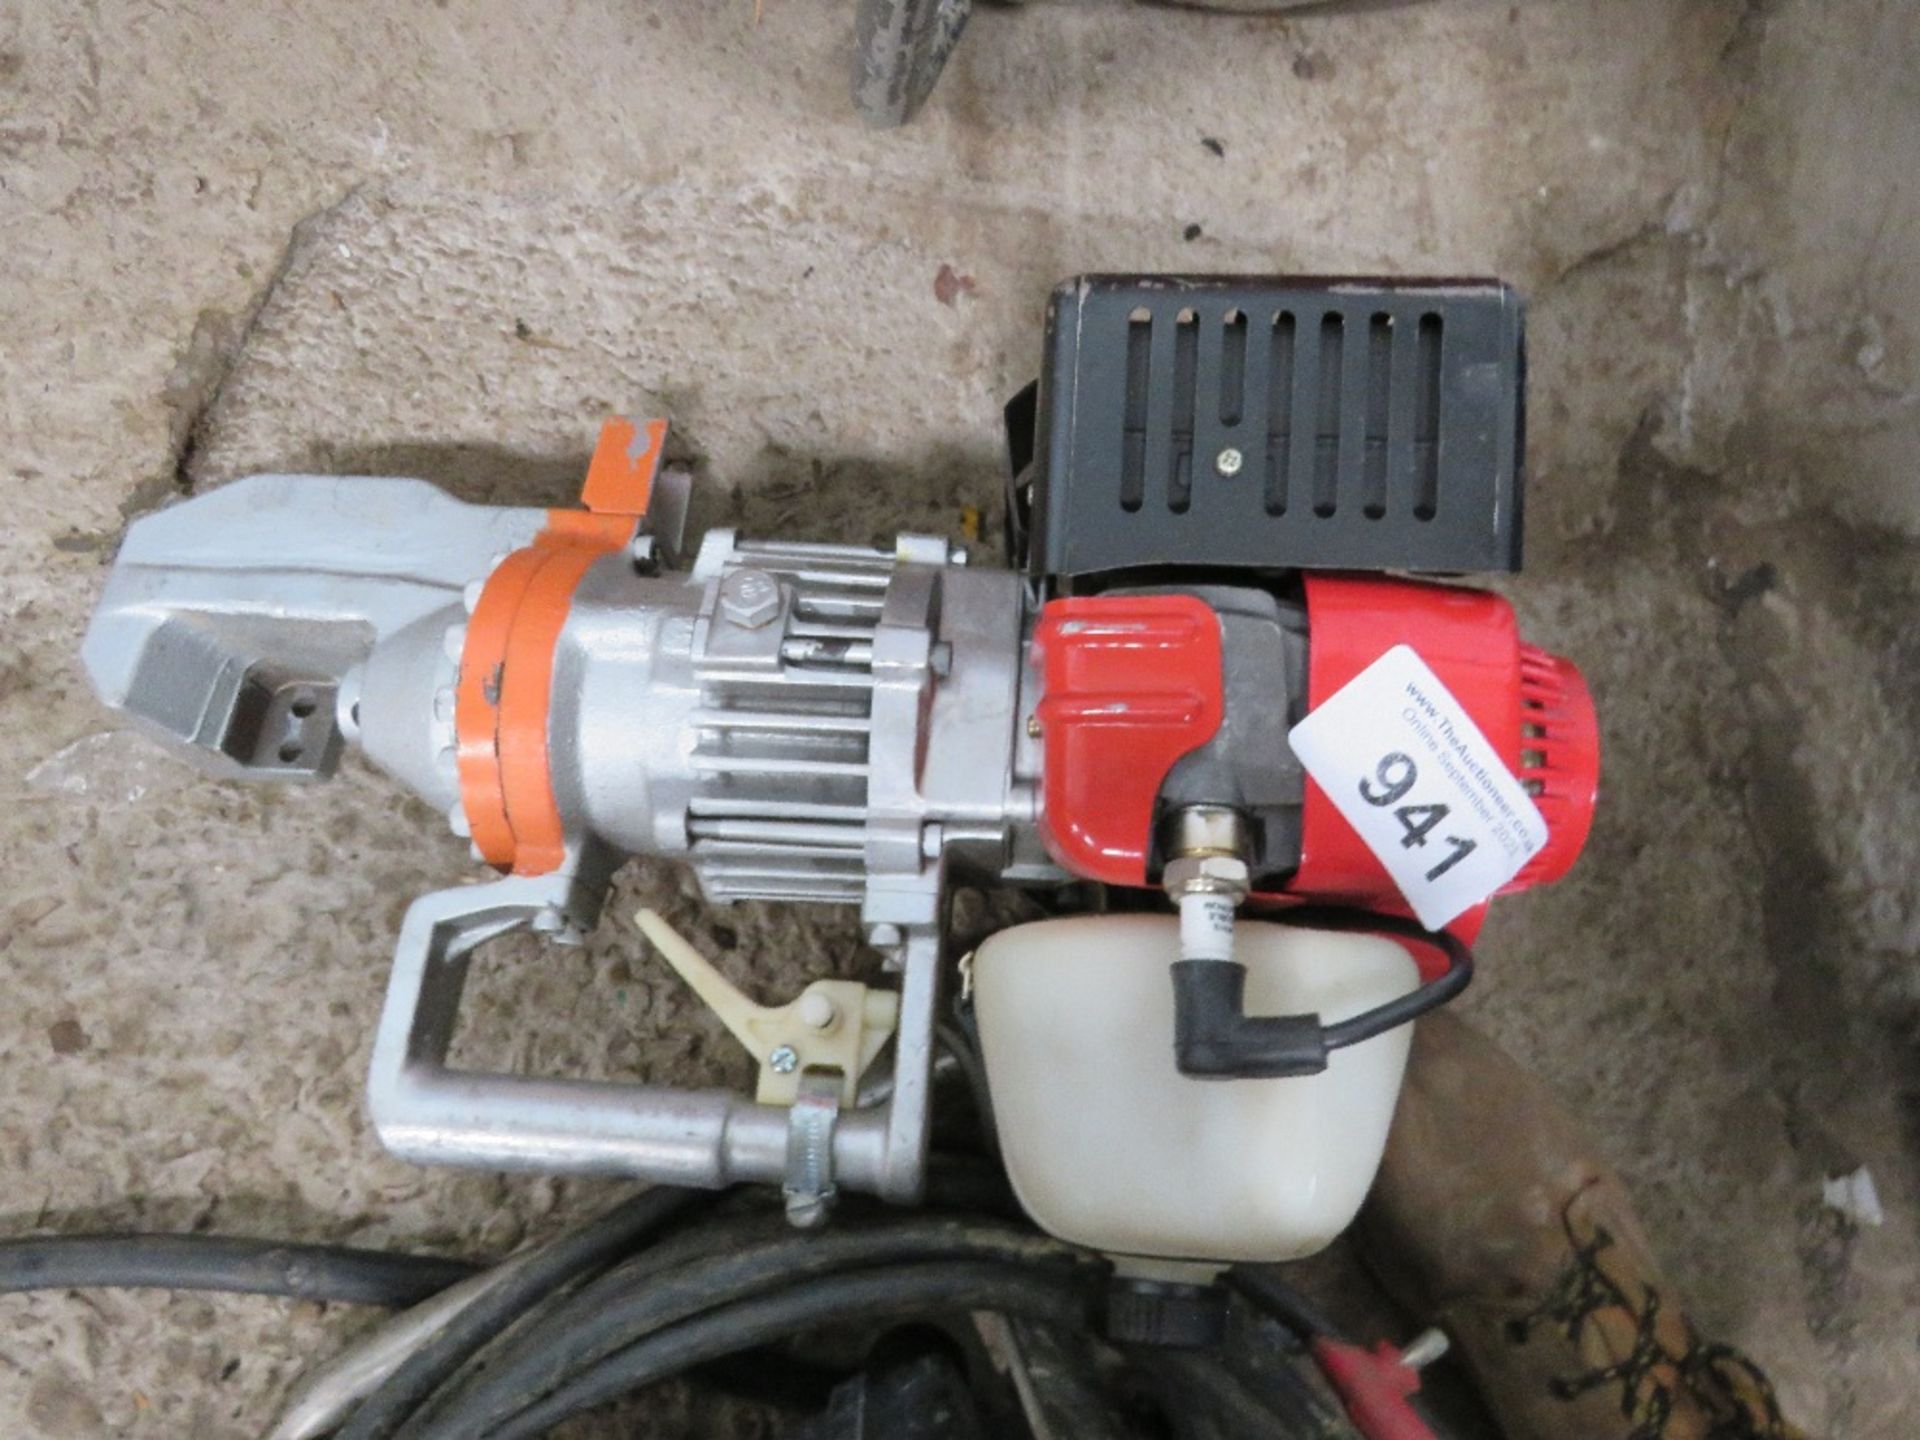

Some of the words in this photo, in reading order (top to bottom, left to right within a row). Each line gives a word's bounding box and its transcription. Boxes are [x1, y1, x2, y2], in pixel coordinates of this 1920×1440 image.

[1359, 751, 1477, 882] 941
[1402, 707, 1438, 751] Online
[1438, 752, 1494, 823] September
